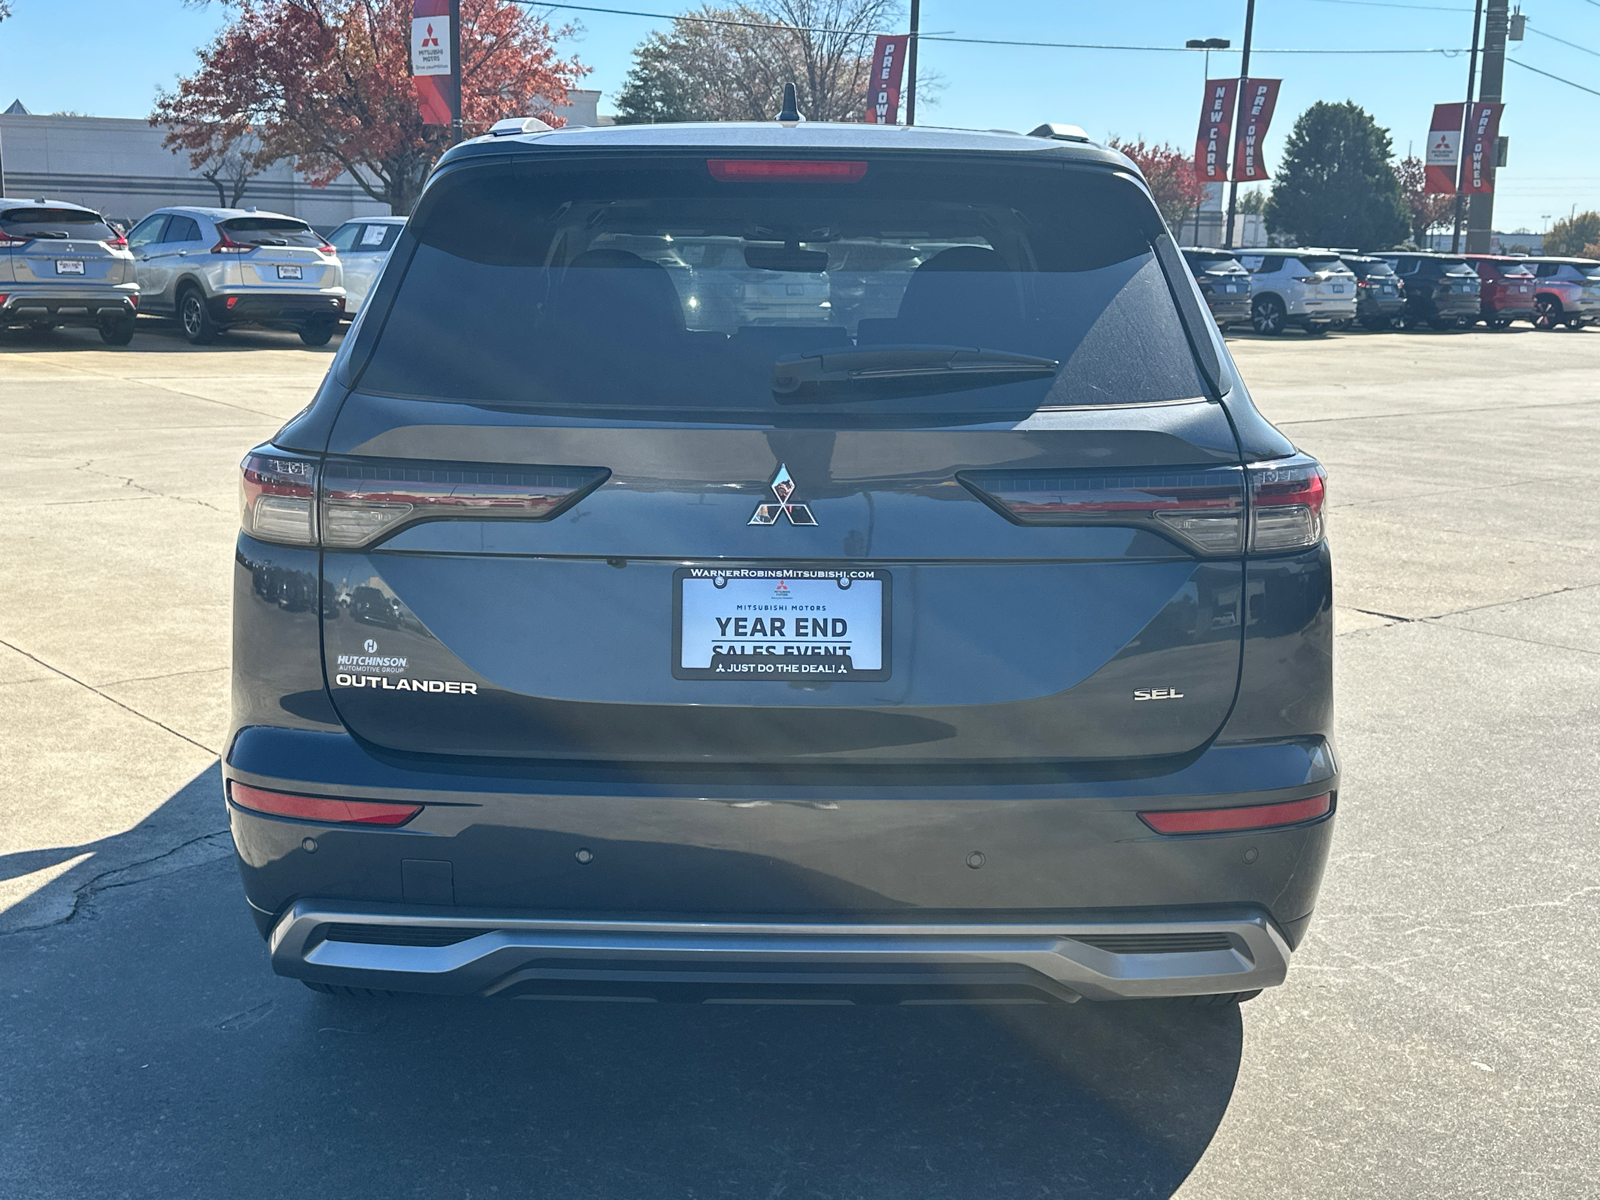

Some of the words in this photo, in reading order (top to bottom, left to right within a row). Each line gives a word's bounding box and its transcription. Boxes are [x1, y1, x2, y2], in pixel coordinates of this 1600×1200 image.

[1210, 86, 1226, 123] NEW
[1245, 85, 1268, 176] PRE-OWNED
[1207, 127, 1218, 176] CARS
[1472, 108, 1492, 188] PRE-OWNED
[715, 617, 786, 637] YEAR
[795, 618, 848, 638] END
[337, 655, 407, 667] HUTCHINSON
[338, 665, 380, 673] AUTOMOTIVE
[381, 666, 405, 674] GROUP
[727, 663, 756, 672] JUST
[757, 664, 775, 672] DO
[776, 664, 800, 673] THE
[801, 664, 835, 673] DEAL!
[335, 673, 478, 695] OUTLANDER
[1133, 686, 1184, 701] SEL
